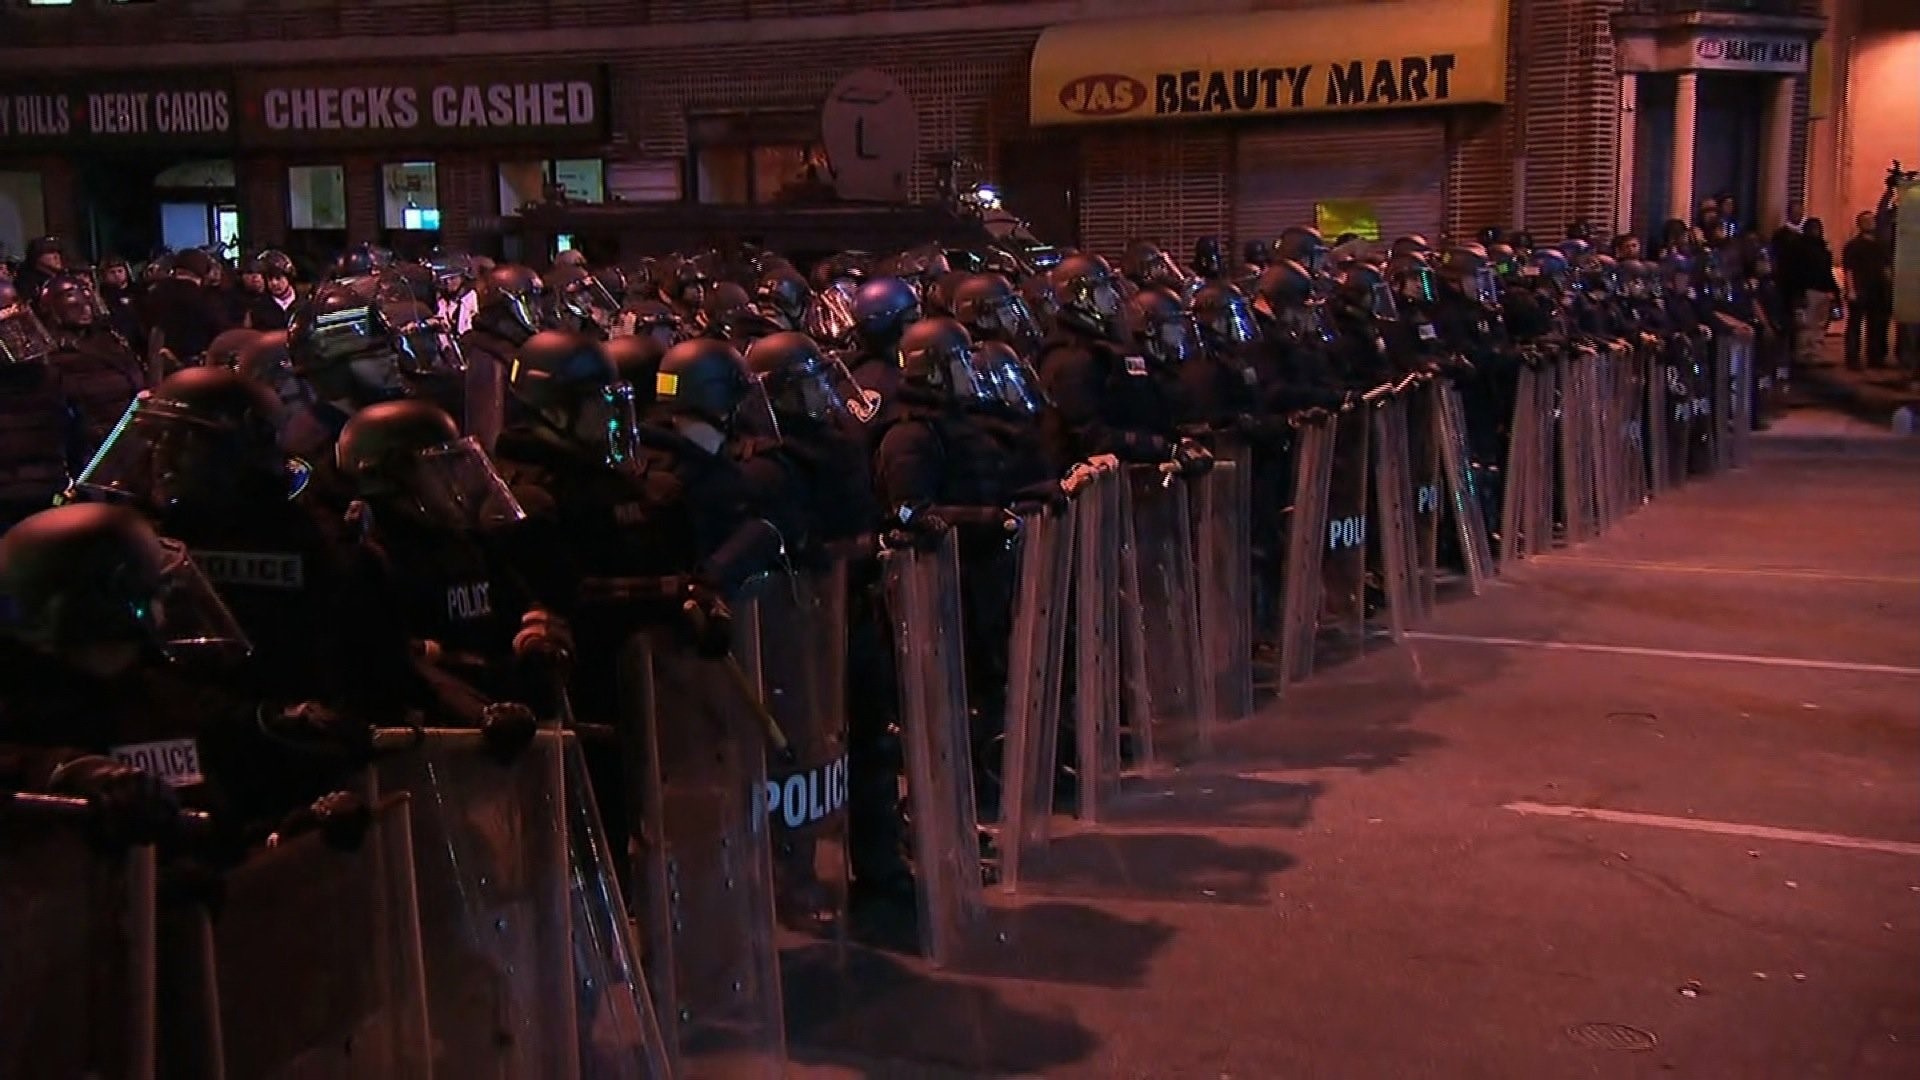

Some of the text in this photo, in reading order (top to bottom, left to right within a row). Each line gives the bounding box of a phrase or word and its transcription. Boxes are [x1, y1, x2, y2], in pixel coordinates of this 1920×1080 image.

[263, 81, 595, 130] CHECKS CASHED
[1063, 54, 1456, 114] JAS BEAUTY MART
[16, 94, 70, 136] BILLS
[87, 92, 150, 134] DEBIT
[154, 88, 231, 133] CARDS
[190, 557, 299, 585] OLICE
